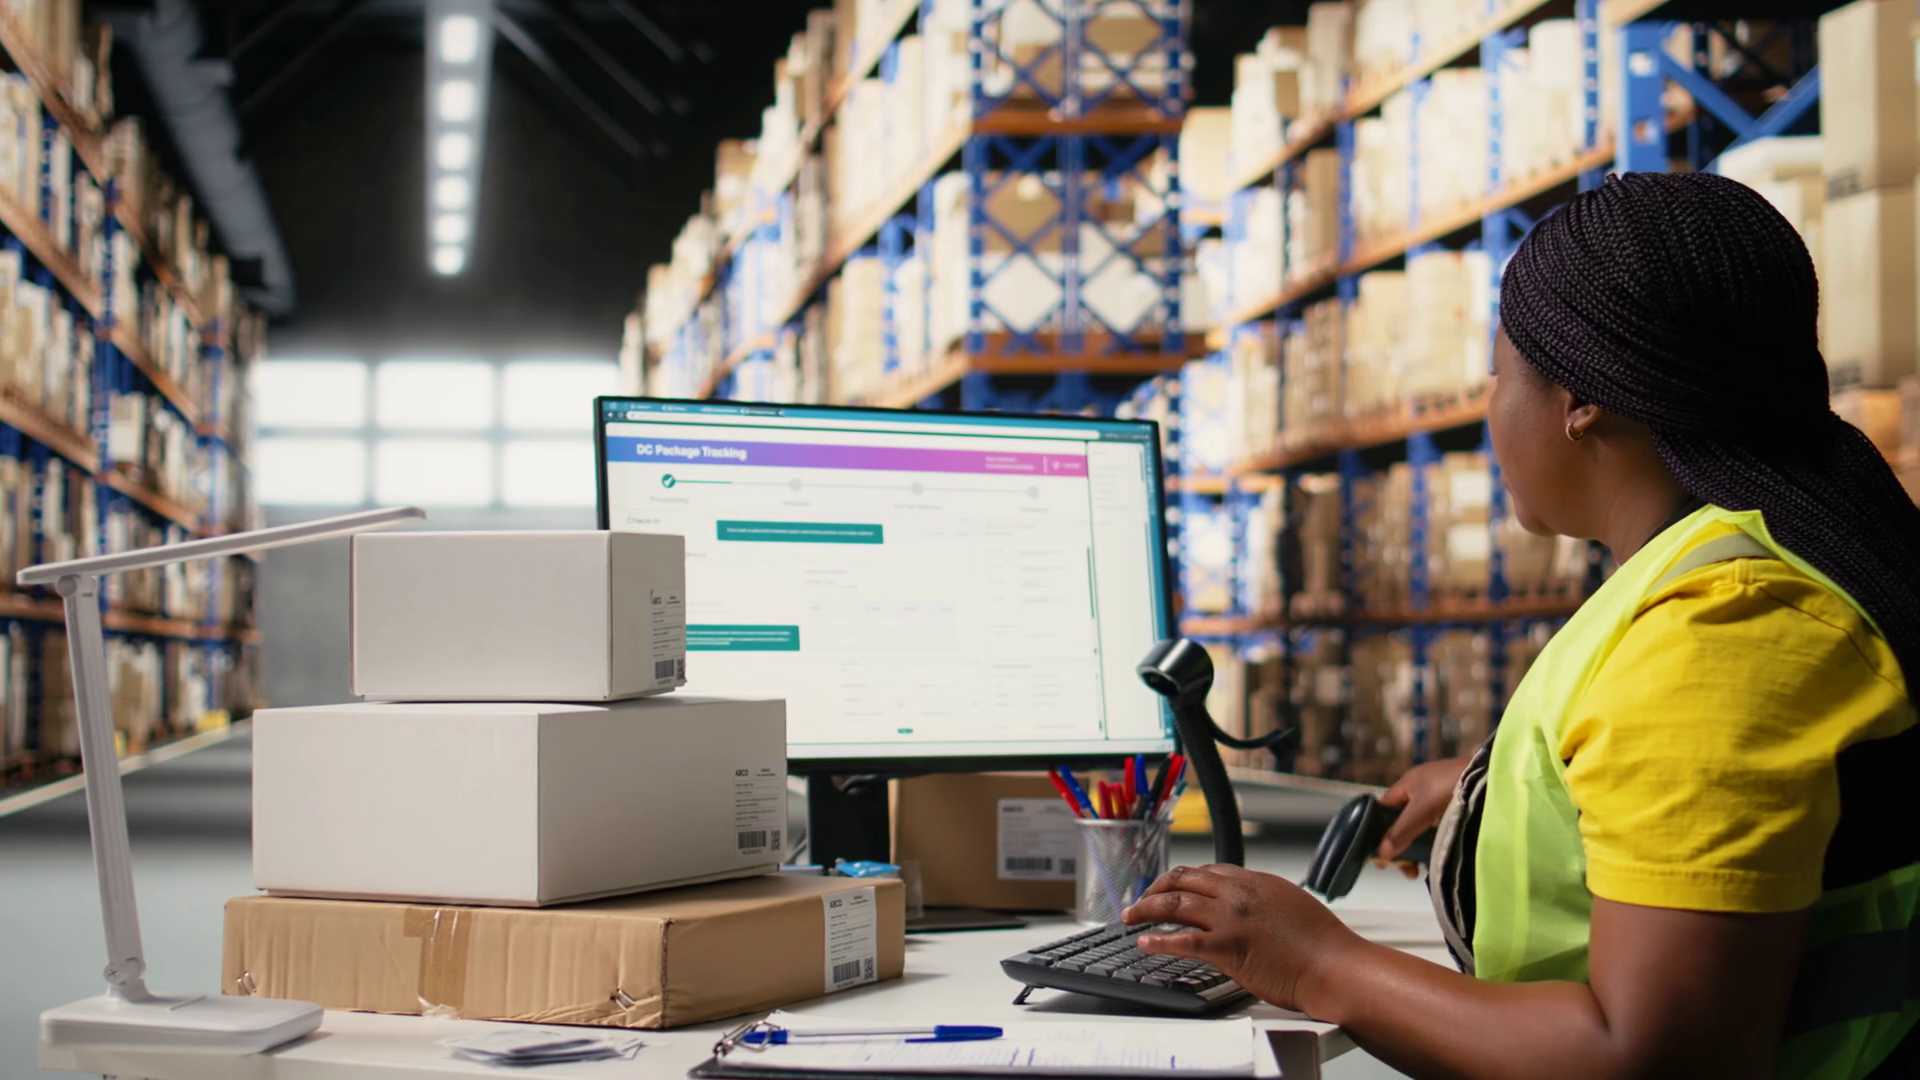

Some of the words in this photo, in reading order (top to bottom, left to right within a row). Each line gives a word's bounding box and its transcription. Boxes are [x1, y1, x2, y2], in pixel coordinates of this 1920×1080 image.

[636, 444, 653, 455] DC
[655, 445, 700, 459] Package
[701, 446, 748, 461] Tracking
